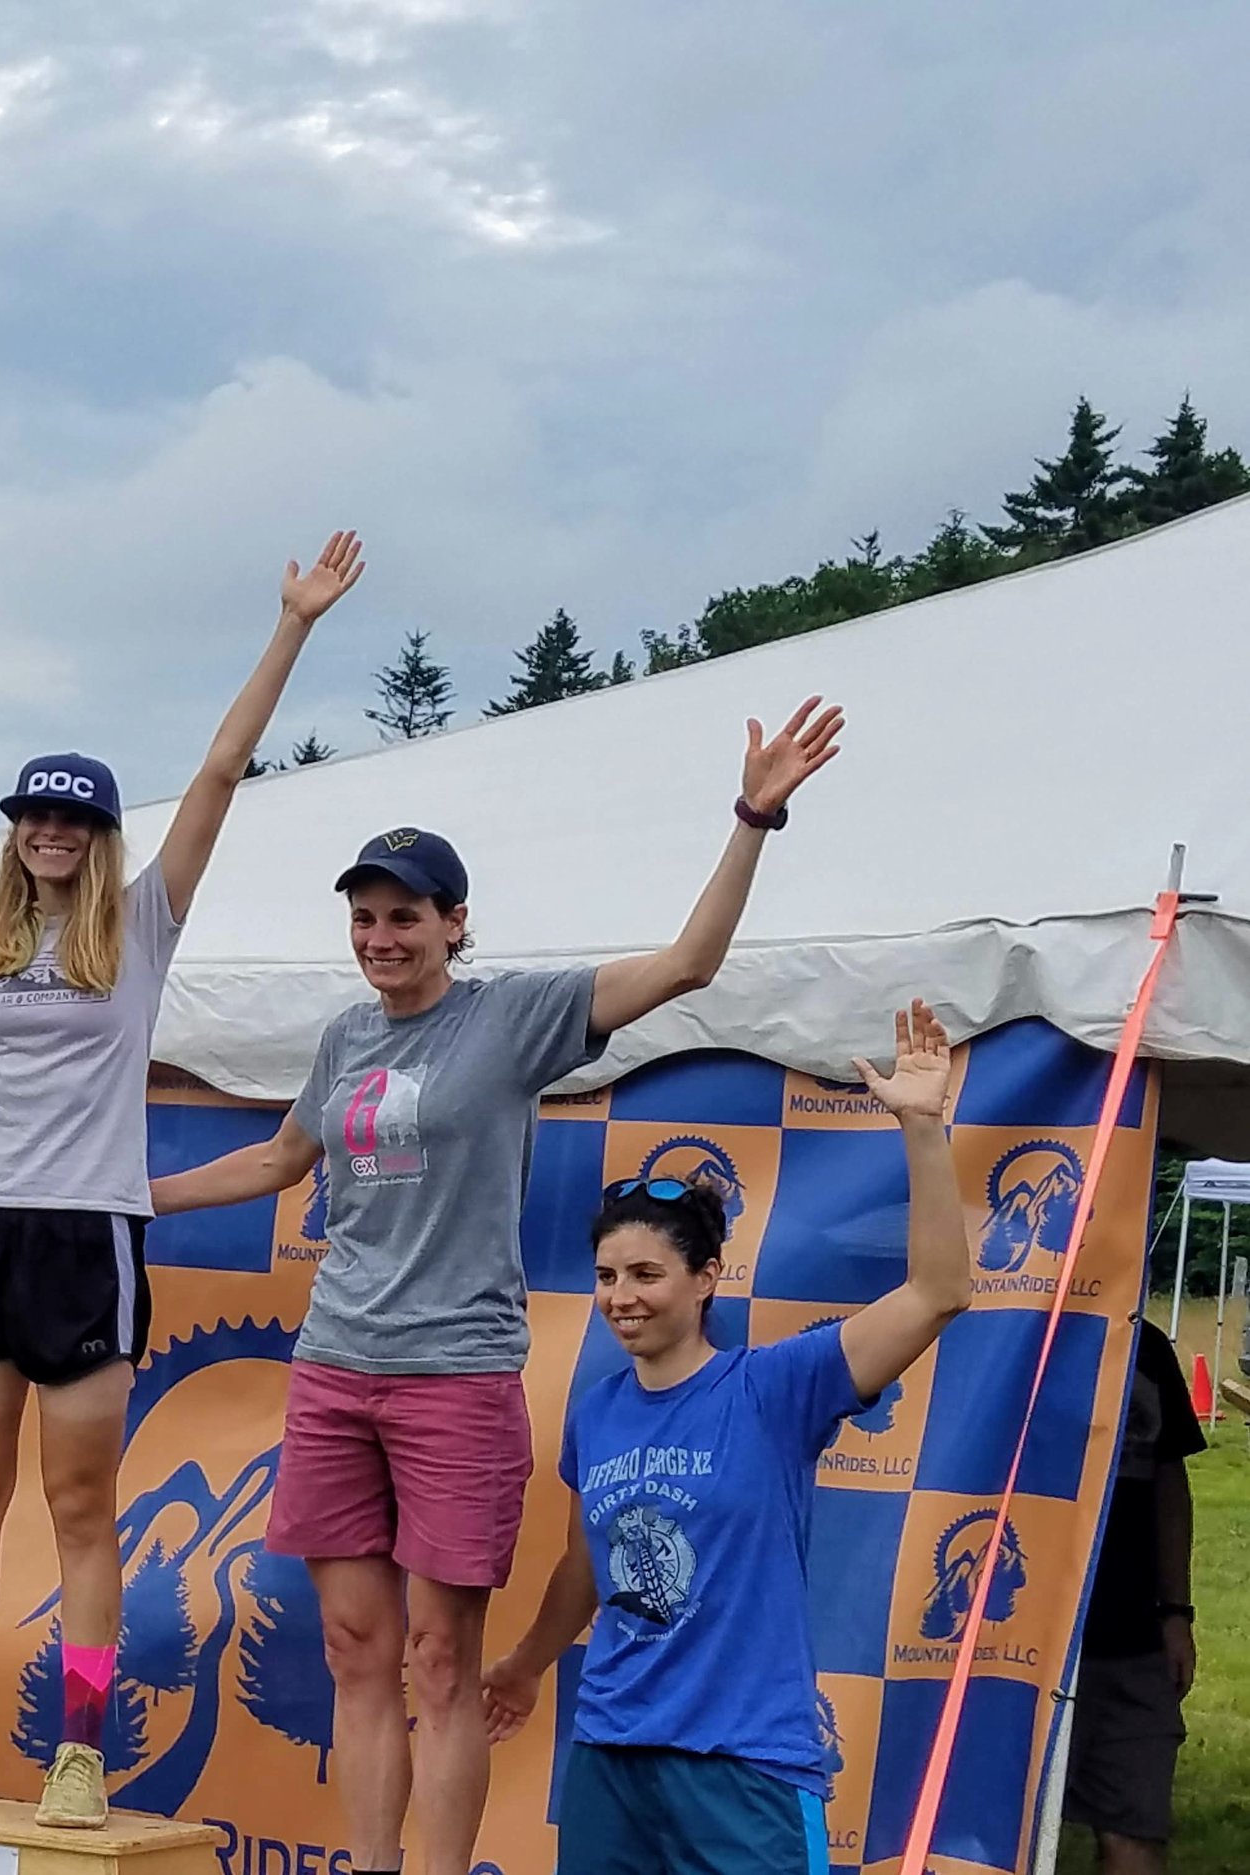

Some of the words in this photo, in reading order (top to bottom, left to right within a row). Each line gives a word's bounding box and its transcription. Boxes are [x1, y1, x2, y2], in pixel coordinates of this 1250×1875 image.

[26, 991, 78, 1003] COMPANY
[351, 1155, 378, 1177] CX
[1070, 1278, 1102, 1297] LLC
[884, 1456, 912, 1475] LLC
[588, 1483, 640, 1525] DIRTY
[645, 1480, 698, 1512] DASH
[1003, 1642, 1040, 1666] LLC
